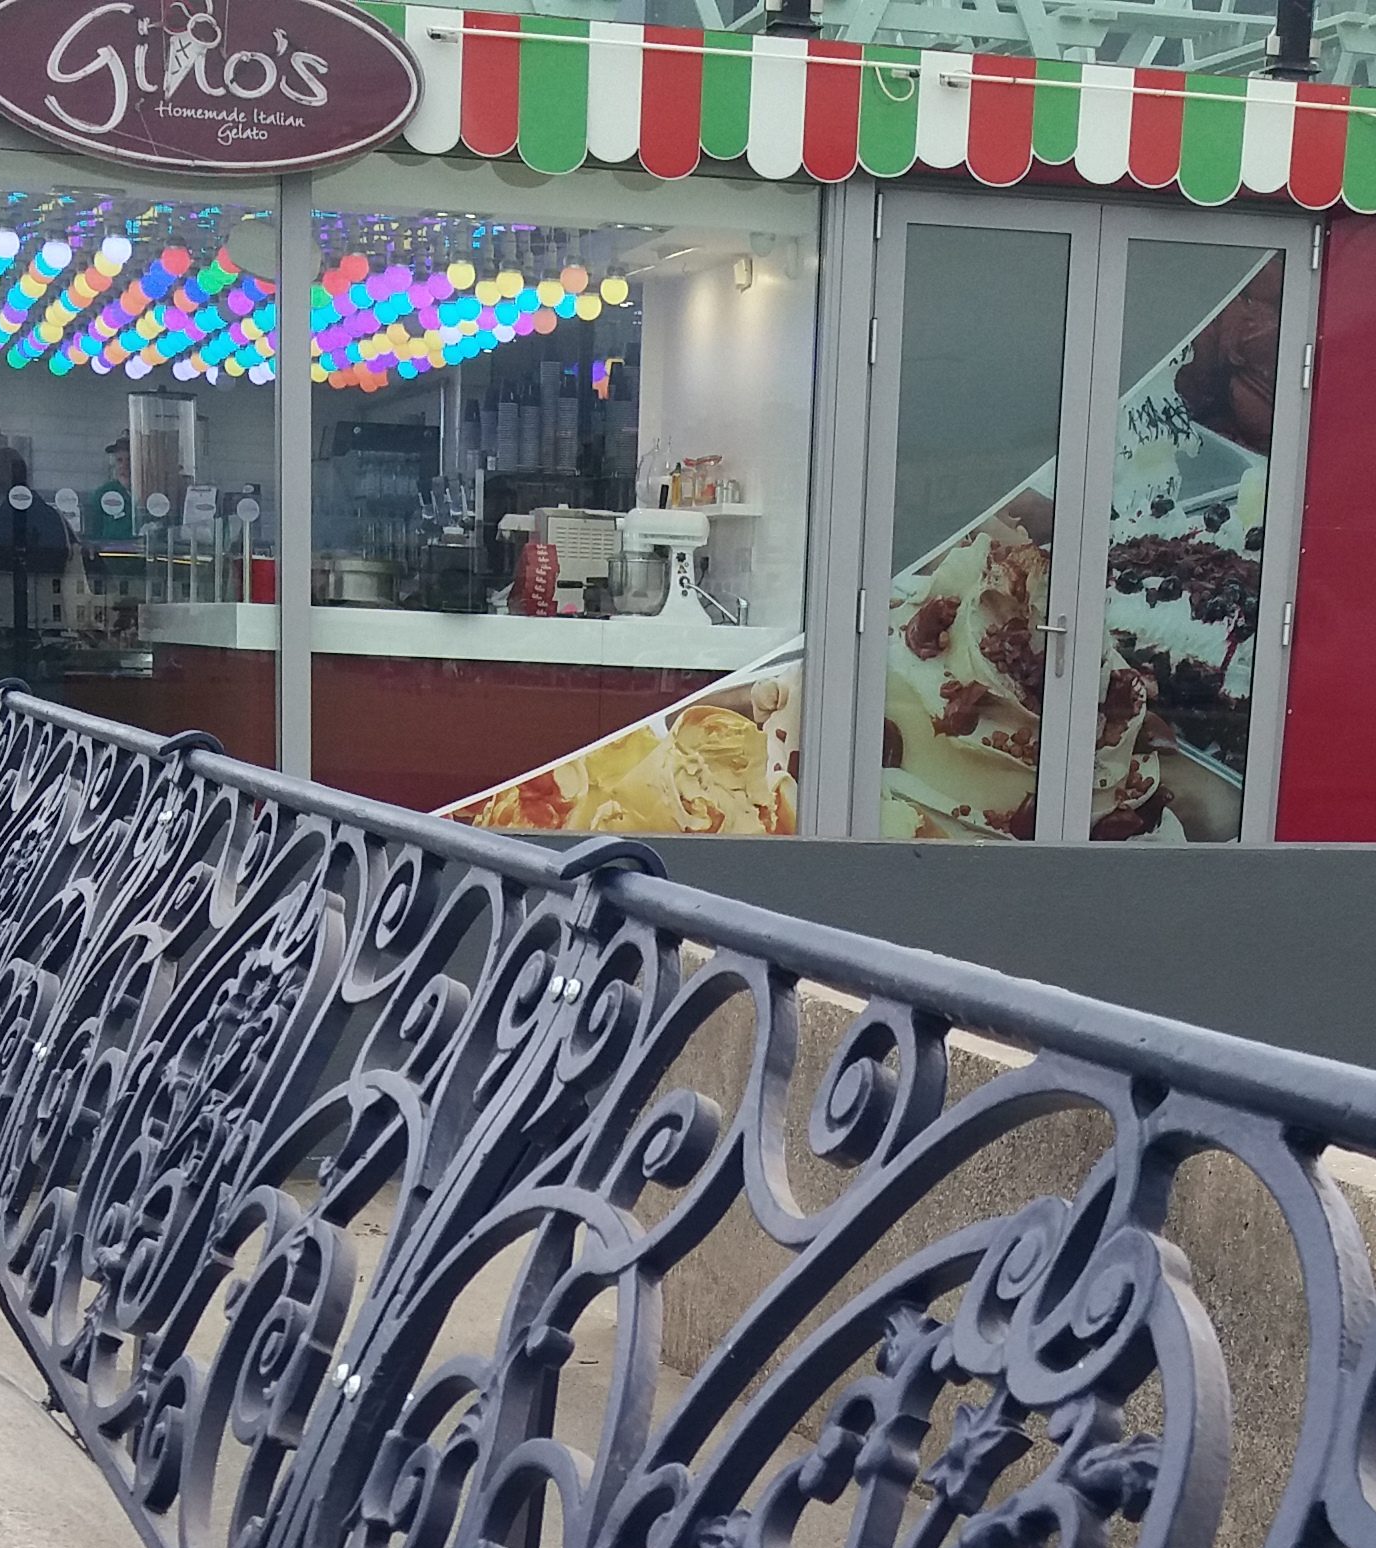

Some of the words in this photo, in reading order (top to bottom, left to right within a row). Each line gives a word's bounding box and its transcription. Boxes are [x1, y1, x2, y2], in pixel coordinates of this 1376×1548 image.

[155, 101, 247, 123] Homemade
[253, 108, 307, 128] Italian
[217, 122, 268, 146] Gelato
